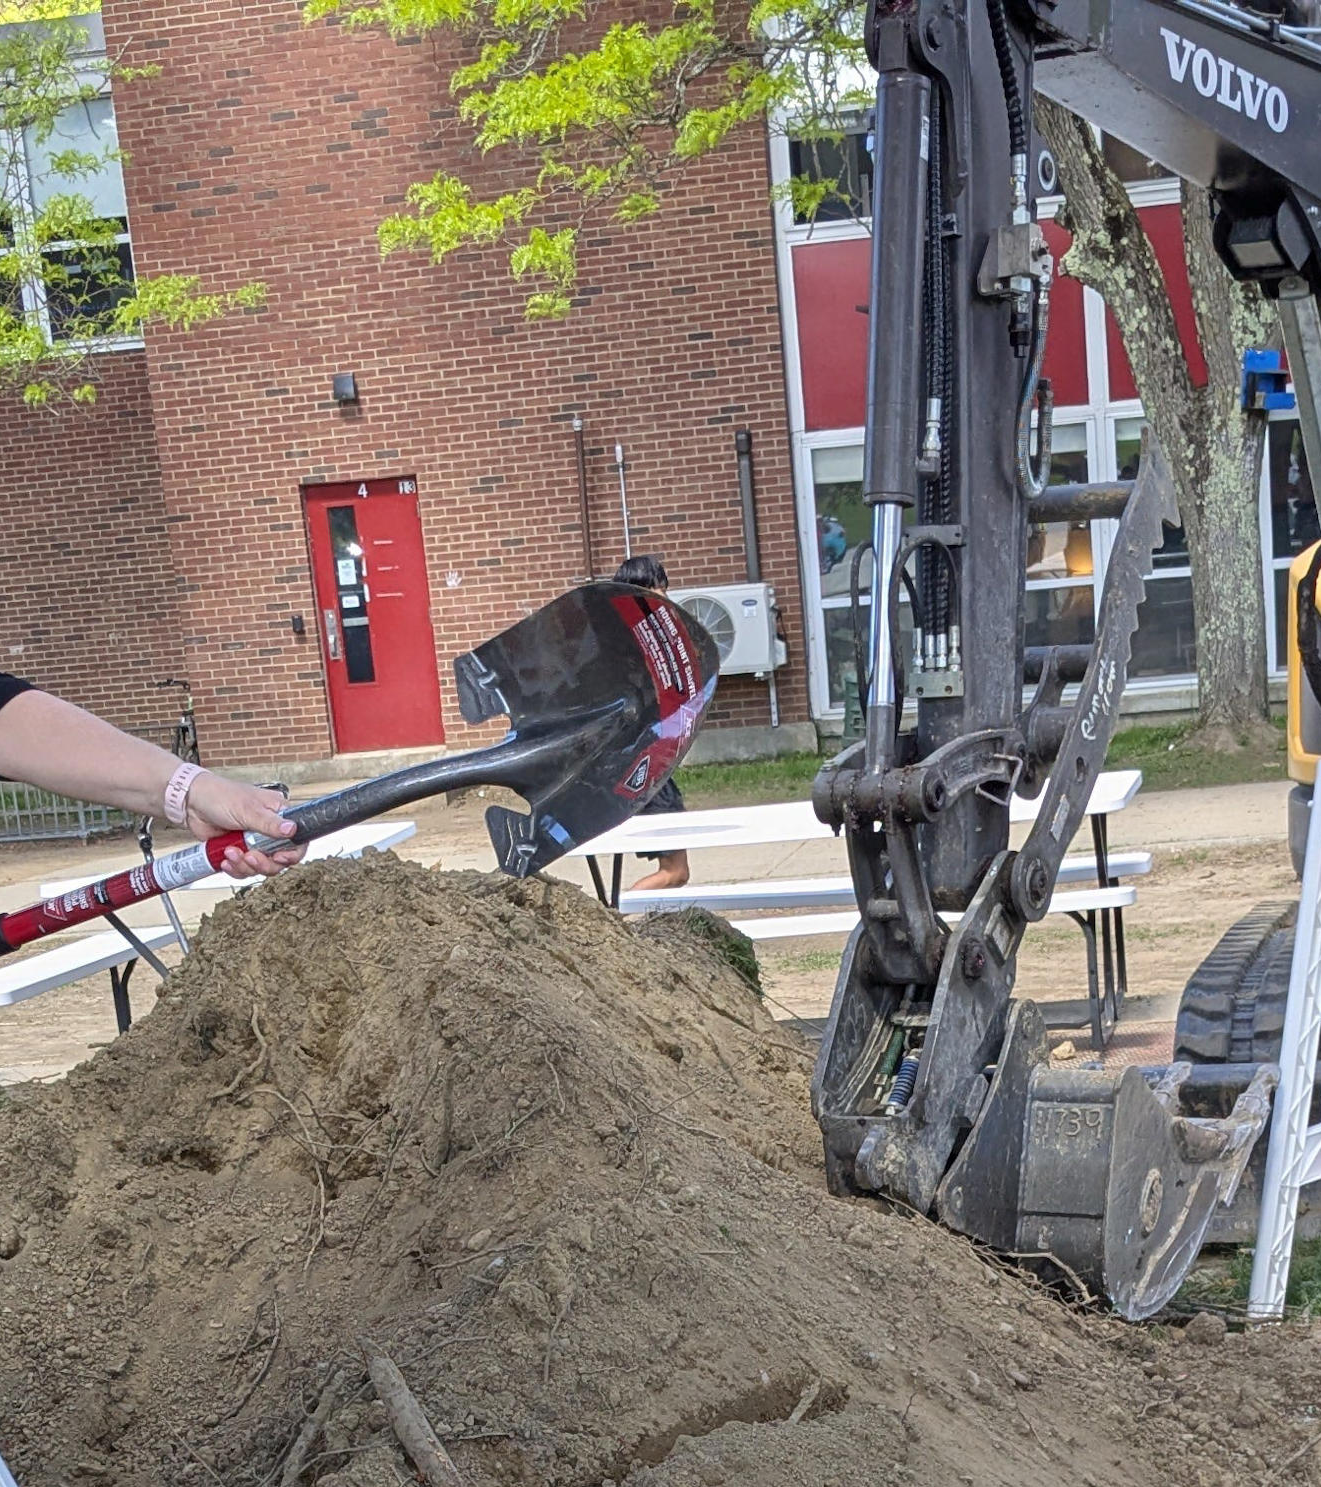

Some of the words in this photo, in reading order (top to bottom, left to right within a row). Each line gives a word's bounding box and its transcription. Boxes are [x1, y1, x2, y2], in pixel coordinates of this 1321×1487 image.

[1160, 27, 1289, 133] VOLVO
[358, 482, 368, 498] 4
[658, 606, 678, 636] ROUND
[675, 636, 690, 664] POINT
[684, 665, 697, 700] SHOVEL
